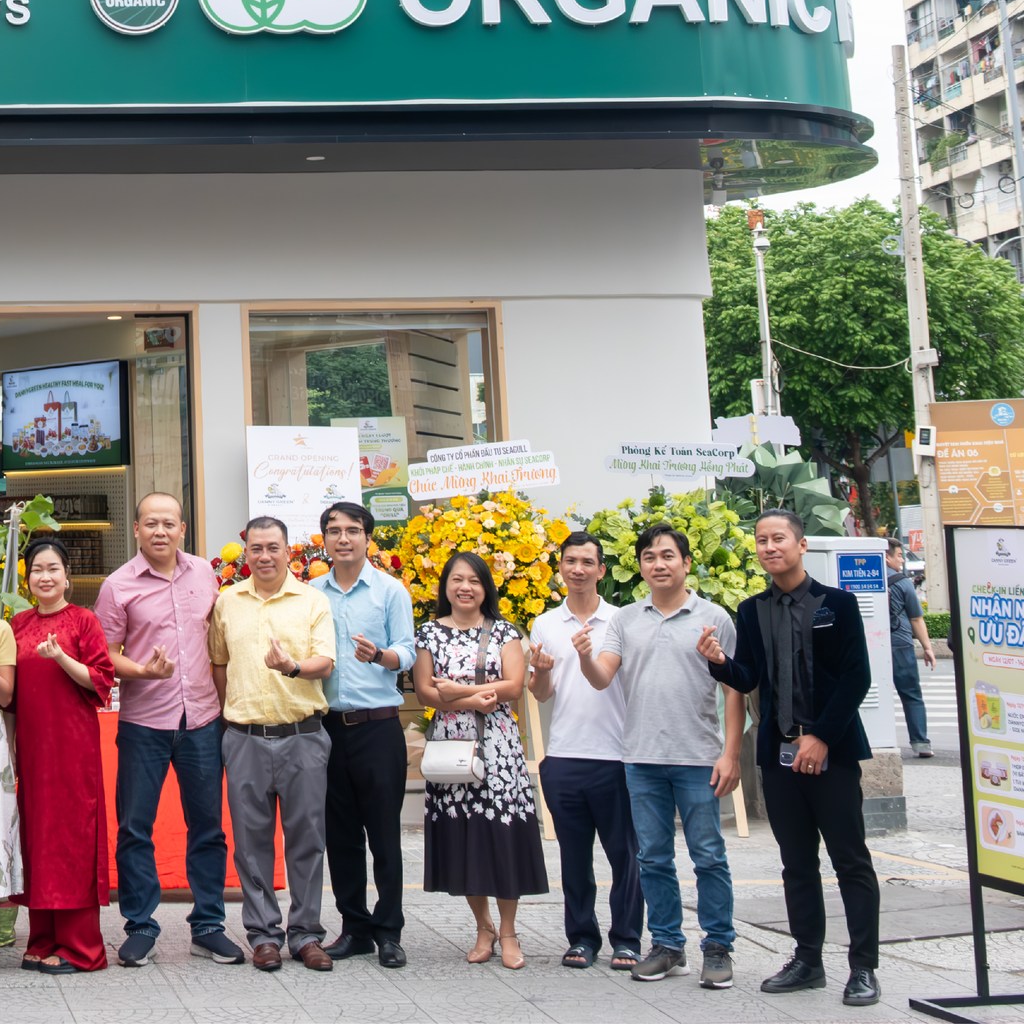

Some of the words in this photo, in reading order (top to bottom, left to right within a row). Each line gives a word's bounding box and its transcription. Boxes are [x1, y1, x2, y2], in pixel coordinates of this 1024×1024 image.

[268, 454, 299, 462] GRAND
[301, 454, 339, 462] OPENING
[447, 453, 454, 461] TY
[502, 444, 528, 455] SEAGULL
[621, 445, 651, 457] Phòng
[654, 445, 667, 456] Kế
[669, 445, 693, 457] Toán
[696, 447, 735, 459] SeaCorp
[253, 460, 354, 482] Congratulations!
[409, 478, 437, 494] Chúc
[440, 474, 477, 492] Mừng
[480, 471, 508, 487] Khai
[972, 584, 1006, 595] CHECK-IN
